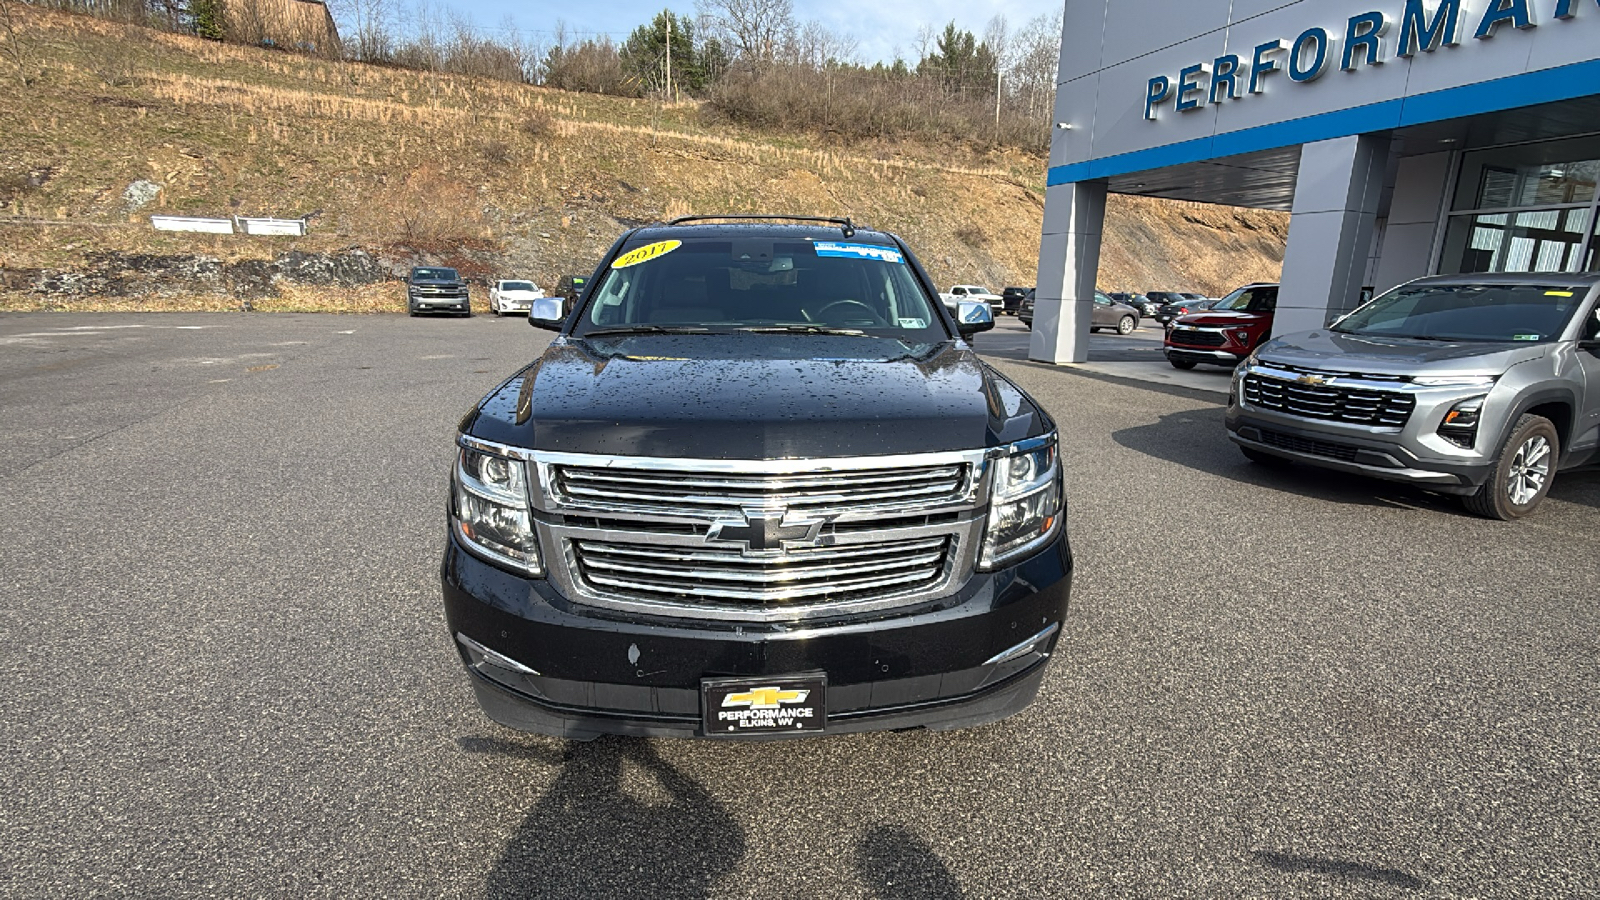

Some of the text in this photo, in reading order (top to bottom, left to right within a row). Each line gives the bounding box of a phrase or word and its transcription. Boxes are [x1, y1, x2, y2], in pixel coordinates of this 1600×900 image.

[1143, 0, 1600, 120] PERFORMA
[624, 242, 667, 266] 2017
[718, 707, 814, 721] PERFORMANCE
[739, 717, 794, 728] ELKINS, WV
